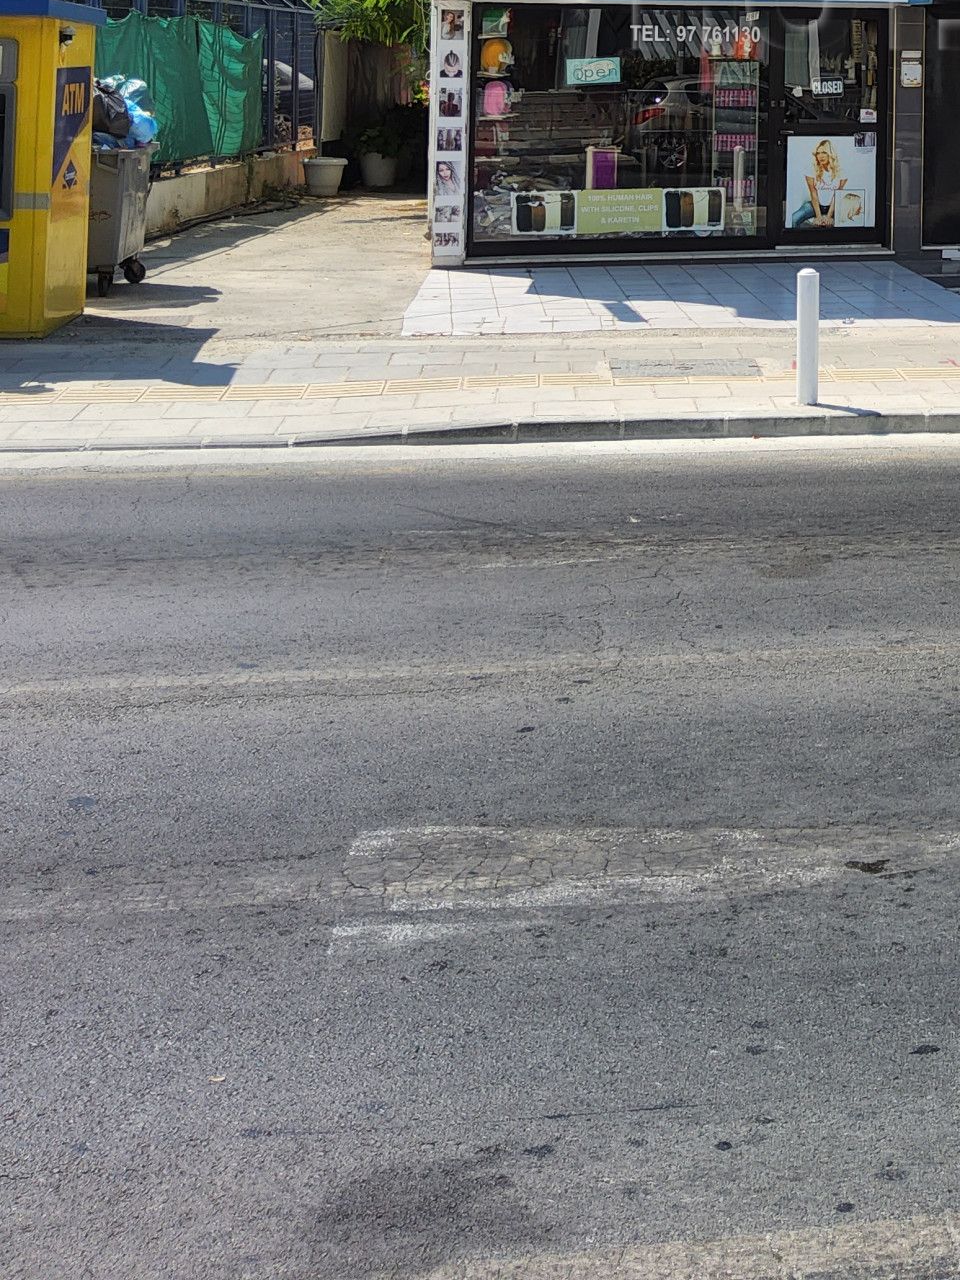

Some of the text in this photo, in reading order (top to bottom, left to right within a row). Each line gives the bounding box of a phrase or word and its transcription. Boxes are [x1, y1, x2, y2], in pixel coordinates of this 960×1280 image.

[630, 24, 760, 42] TEL: 97 761130
[813, 81, 843, 94] CLOSED
[61, 82, 85, 116] ATM
